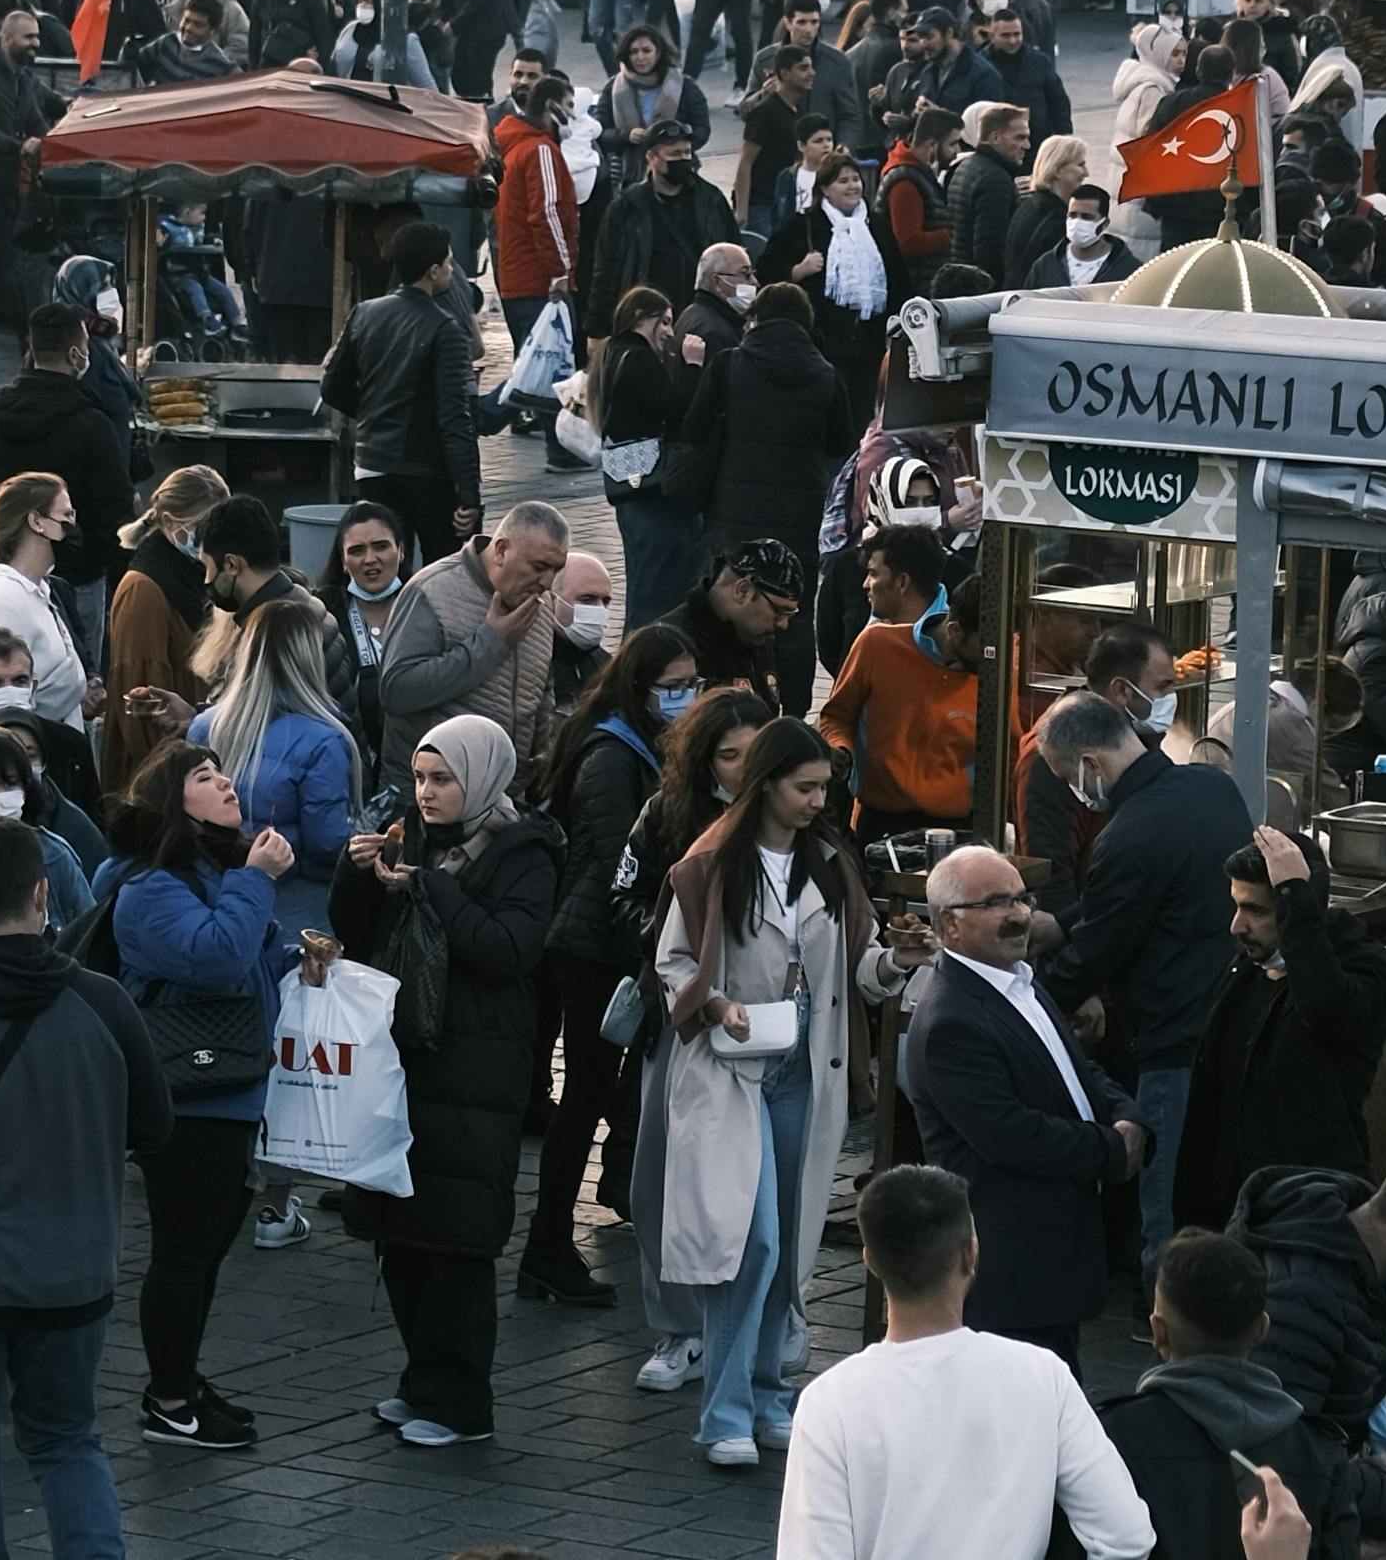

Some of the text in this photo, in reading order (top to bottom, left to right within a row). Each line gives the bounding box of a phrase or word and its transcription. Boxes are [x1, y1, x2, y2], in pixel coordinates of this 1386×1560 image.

[1046, 360, 1297, 433] OSMANLI
[1065, 464, 1183, 505] LOKMASI
[270, 1036, 360, 1077] UAT
